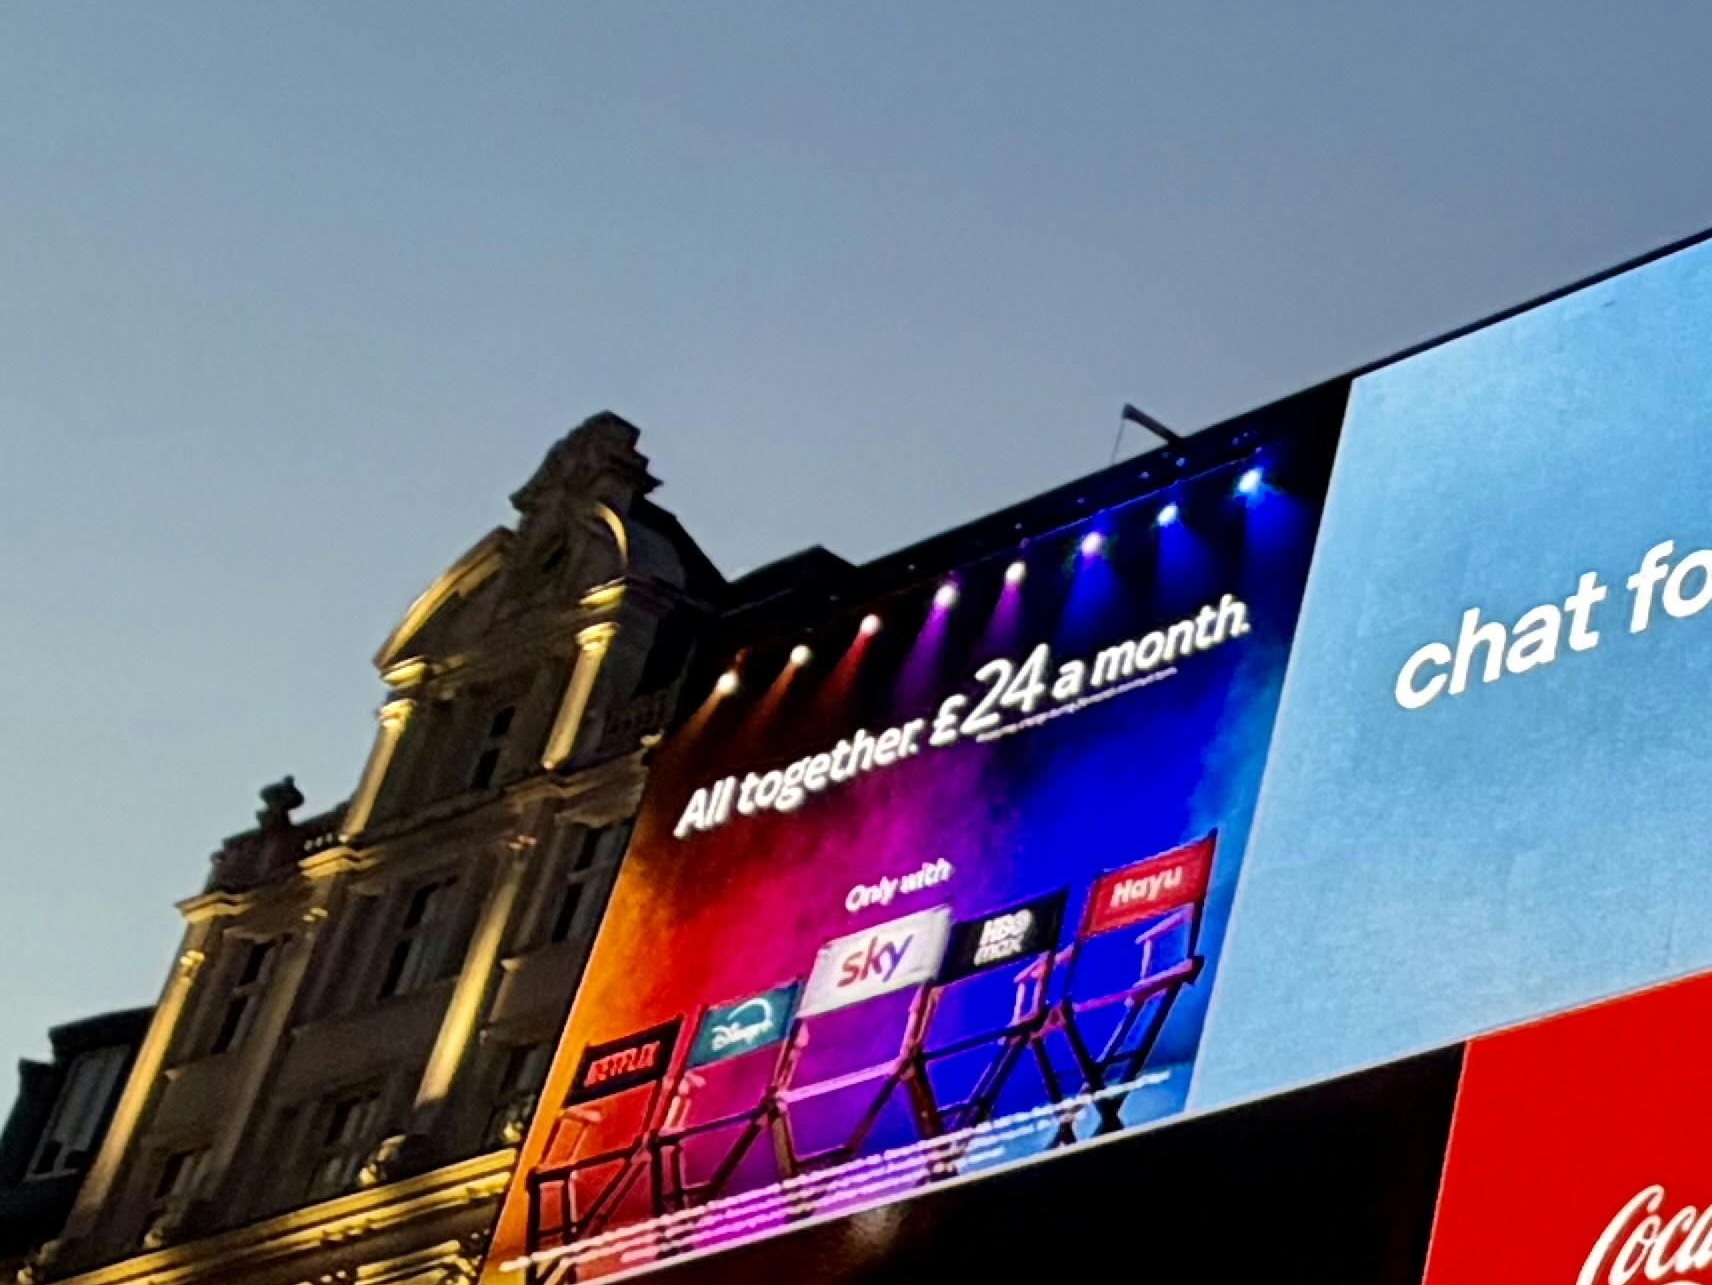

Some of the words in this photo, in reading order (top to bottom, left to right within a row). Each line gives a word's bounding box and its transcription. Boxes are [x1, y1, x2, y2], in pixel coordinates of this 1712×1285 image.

[1395, 571, 1606, 710] chat
[673, 775, 736, 838] All
[737, 716, 922, 813] together.
[928, 643, 1052, 746] £24
[1051, 660, 1084, 701] a
[1088, 593, 1252, 689] month.
[845, 878, 899, 913] Only
[899, 857, 954, 894] with
[979, 909, 1034, 941] HBO
[838, 932, 915, 989] sky
